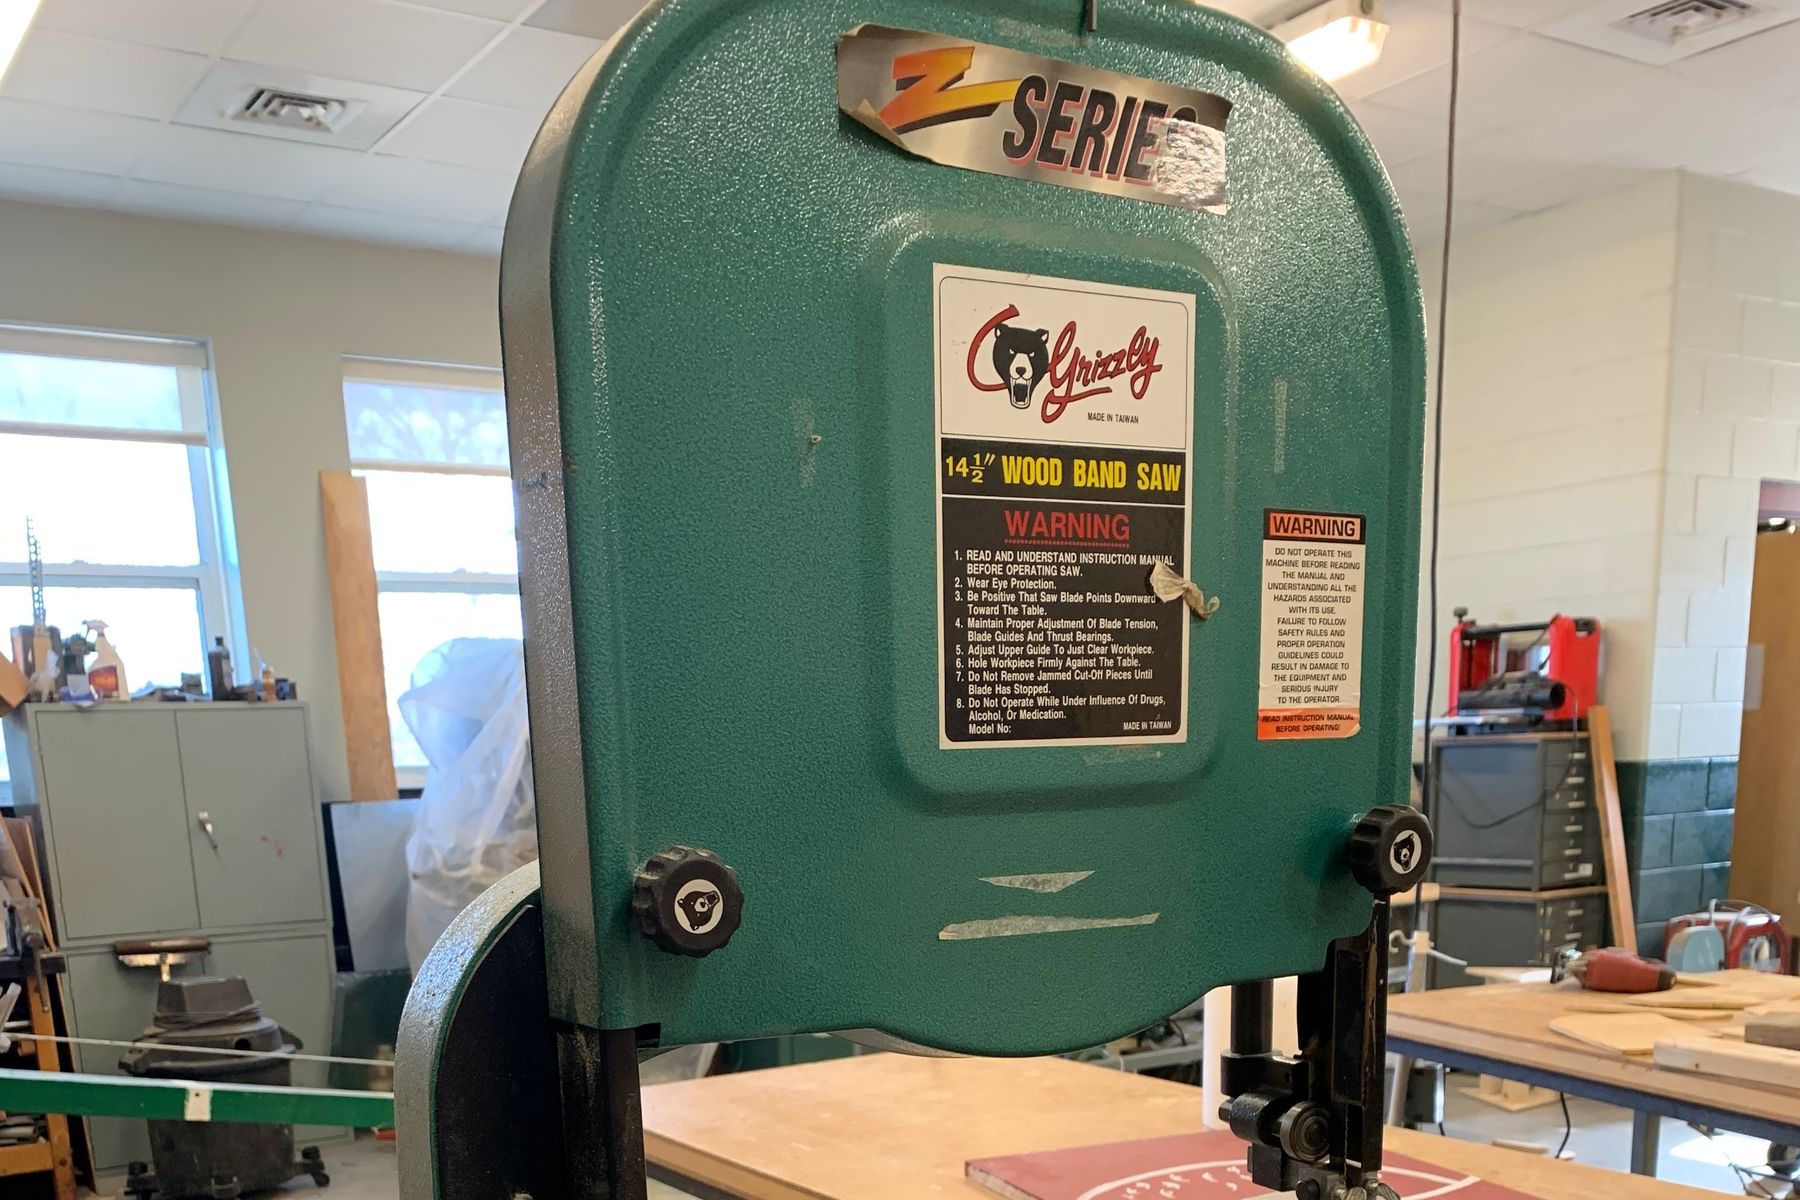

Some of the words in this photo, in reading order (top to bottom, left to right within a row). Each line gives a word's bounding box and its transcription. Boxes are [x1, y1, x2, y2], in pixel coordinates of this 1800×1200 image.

[878, 46, 1022, 133] Z
[1003, 74, 1199, 186] SERIE
[1041, 320, 1163, 424] Grizzly
[1087, 412, 1105, 421] MADE
[1106, 413, 1113, 422] IN
[1115, 413, 1139, 424] TAIWAN
[1002, 455, 1062, 486] WOOD
[1074, 459, 1127, 488] BAND
[1137, 463, 1181, 491] SAW
[1004, 510, 1130, 541] WARNING
[1273, 515, 1356, 537] WARNING
[954, 551, 963, 561] 1.
[967, 550, 991, 561] READ
[995, 551, 1014, 562] AND
[1017, 551, 1077, 563] UNDERSTAND
[1080, 553, 1136, 565] INSTRUCTION
[1275, 547, 1286, 556] DO
[1287, 548, 1302, 556] NOT
[1304, 549, 1335, 557] OPERATE
[1337, 550, 1352, 558] THIS
[967, 563, 1003, 575] BEFORE
[1006, 564, 1058, 576] OPERATING
[1060, 565, 1083, 577] SAW.
[1265, 559, 1299, 568] MACHINE
[1301, 560, 1328, 568] BEFORE
[1330, 561, 1360, 570] READING
[1282, 571, 1296, 579] THE
[1297, 571, 1328, 580] MANUAL
[1329, 572, 1345, 581] AND
[955, 577, 963, 588] 2.
[967, 577, 989, 588] Wear
[992, 578, 1008, 591] Eye
[1011, 578, 1057, 590] Protection.
[1267, 582, 1329, 592] UNDERSTANDING
[1330, 584, 1342, 592] ALL
[1344, 584, 1357, 592] THE
[955, 590, 963, 602] 3.
[967, 590, 979, 602] Be
[982, 590, 1016, 602] Positive
[1018, 591, 1038, 602] That
[1040, 591, 1058, 603] Saw
[1060, 592, 1083, 603] Blade
[1086, 592, 1112, 603] Points
[1115, 592, 1156, 604] Downward
[1273, 594, 1307, 602] HAZARDS
[1309, 595, 1351, 603] ASSOCIATED
[967, 604, 999, 615] Toward
[1002, 604, 1019, 615] The
[1022, 604, 1047, 616] Table.
[1288, 606, 1307, 614] WITH
[1309, 606, 1320, 614] ITS
[955, 618, 964, 628] 4.
[967, 617, 1004, 628] Maintain
[1006, 617, 1035, 631] Proper
[1037, 618, 1084, 630] Adjustment
[1087, 618, 1097, 629] Of
[1099, 618, 1122, 629] Blade
[1124, 618, 1159, 630] Tension,
[1277, 617, 1306, 625] FAILURE
[1308, 617, 1317, 625] TO
[1318, 617, 1347, 626] FOLLOW
[967, 631, 992, 642] Blade
[994, 631, 1024, 642] Guides
[1027, 631, 1044, 642] And
[1046, 631, 1074, 642] Thrust
[1076, 631, 1114, 644] Bearings.
[1278, 629, 1304, 637] SAFETY
[1306, 629, 1328, 637] RULES
[1330, 629, 1345, 637] AND
[1277, 640, 1305, 648] PROPER
[1306, 640, 1345, 648] OPERATION
[955, 644, 964, 655] 5.
[968, 644, 995, 657] Adjust
[998, 644, 1024, 657] Upper
[1026, 644, 1051, 655] Guide
[1053, 644, 1065, 654] To
[1067, 644, 1085, 655] Just
[1087, 644, 1108, 654] Clear
[1278, 651, 1320, 659] GUIDELINES
[1321, 651, 1344, 659] COULD
[955, 657, 964, 668] 6.
[990, 657, 1035, 670] Workpiece
[1037, 657, 1063, 670] Firmly
[1065, 657, 1096, 669] Against
[1099, 657, 1114, 667] The
[1117, 656, 1141, 667] Table.
[1309, 662, 1339, 670] DAMAGE
[1341, 662, 1350, 670] TO
[956, 671, 964, 682] 7.
[968, 671, 980, 682] Do
[983, 671, 998, 681] Not
[1001, 671, 1035, 681] Remove
[1037, 670, 1071, 681] Jammed
[1074, 669, 1103, 680] Cut-Off
[1106, 669, 1132, 680] Pieces
[1134, 669, 1153, 679] Until
[1273, 674, 1287, 682] THE
[1331, 673, 1347, 681] AND
[968, 684, 992, 695] Blade
[995, 684, 1011, 695] Has
[1013, 683, 1051, 696] Stopped.
[1281, 685, 1312, 693] SERIOUS
[1313, 684, 1339, 692] INJURY
[956, 698, 965, 709] 8.
[968, 697, 980, 708] Do
[983, 697, 998, 708] Not
[1001, 697, 1034, 709] Operate
[1036, 696, 1060, 706] While
[1062, 695, 1086, 706] Under
[1089, 695, 1126, 706] Influence
[1128, 694, 1138, 705] Of
[1140, 694, 1166, 706] Drugs,
[1277, 696, 1287, 704] TO
[1289, 696, 1302, 704] THE
[968, 710, 1004, 722] Alcohol,
[1006, 709, 1017, 720] Or
[1019, 709, 1067, 720] Medication.
[1262, 715, 1280, 723] READ
[1282, 714, 1325, 722] INSTRUCTION
[968, 723, 994, 735] Model
[997, 723, 1012, 734] No:
[1123, 722, 1140, 730] MADE
[1141, 721, 1148, 730] IN
[1149, 721, 1172, 730] TAIWAN
[1275, 725, 1301, 733] BEFORE
